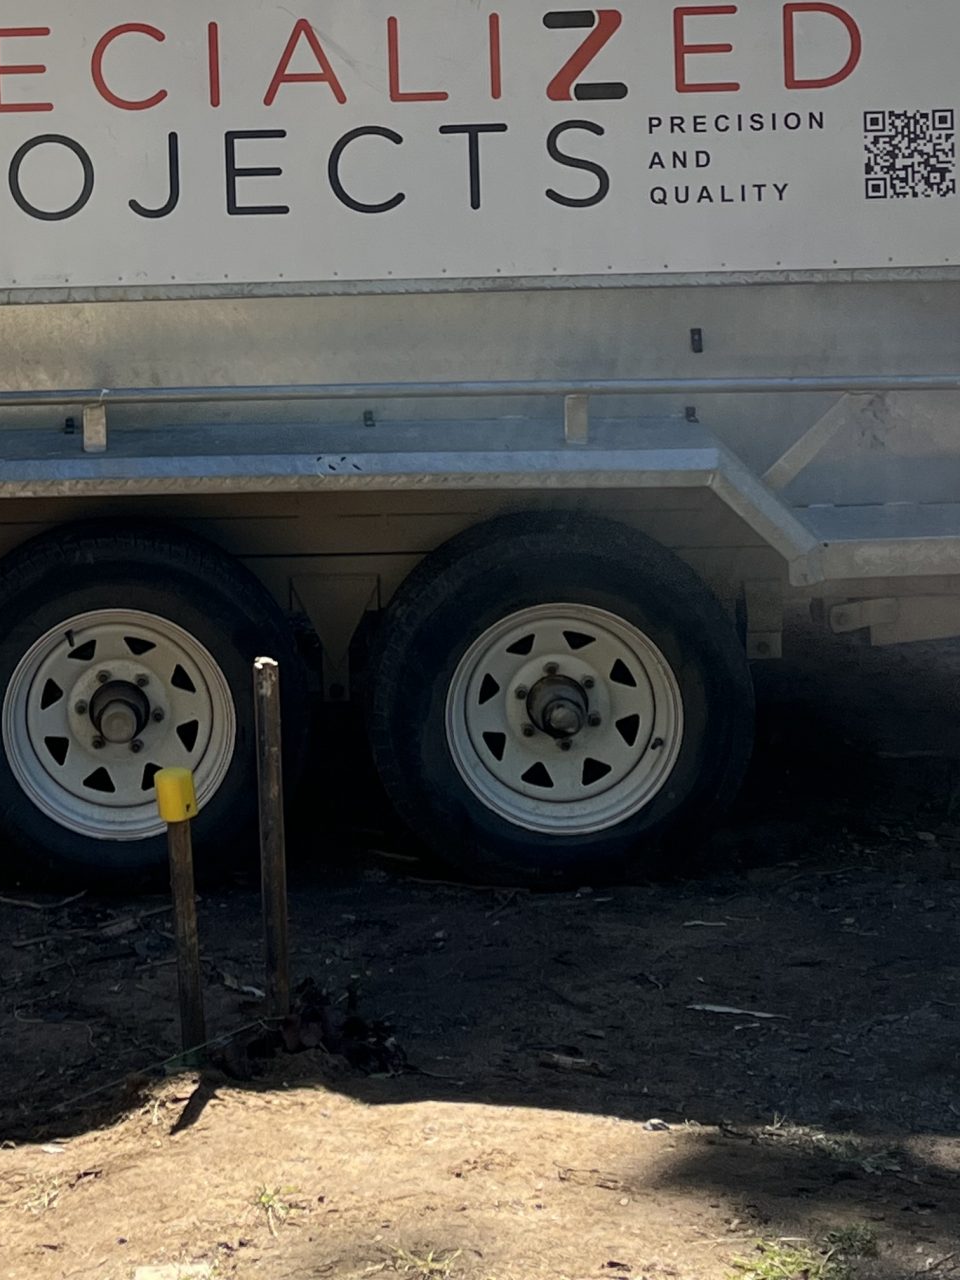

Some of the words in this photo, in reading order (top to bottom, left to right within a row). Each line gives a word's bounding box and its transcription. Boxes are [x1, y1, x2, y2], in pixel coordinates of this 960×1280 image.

[648, 111, 824, 135] PRECISION
[648, 150, 711, 170] AND
[649, 182, 789, 206] QUALITY
